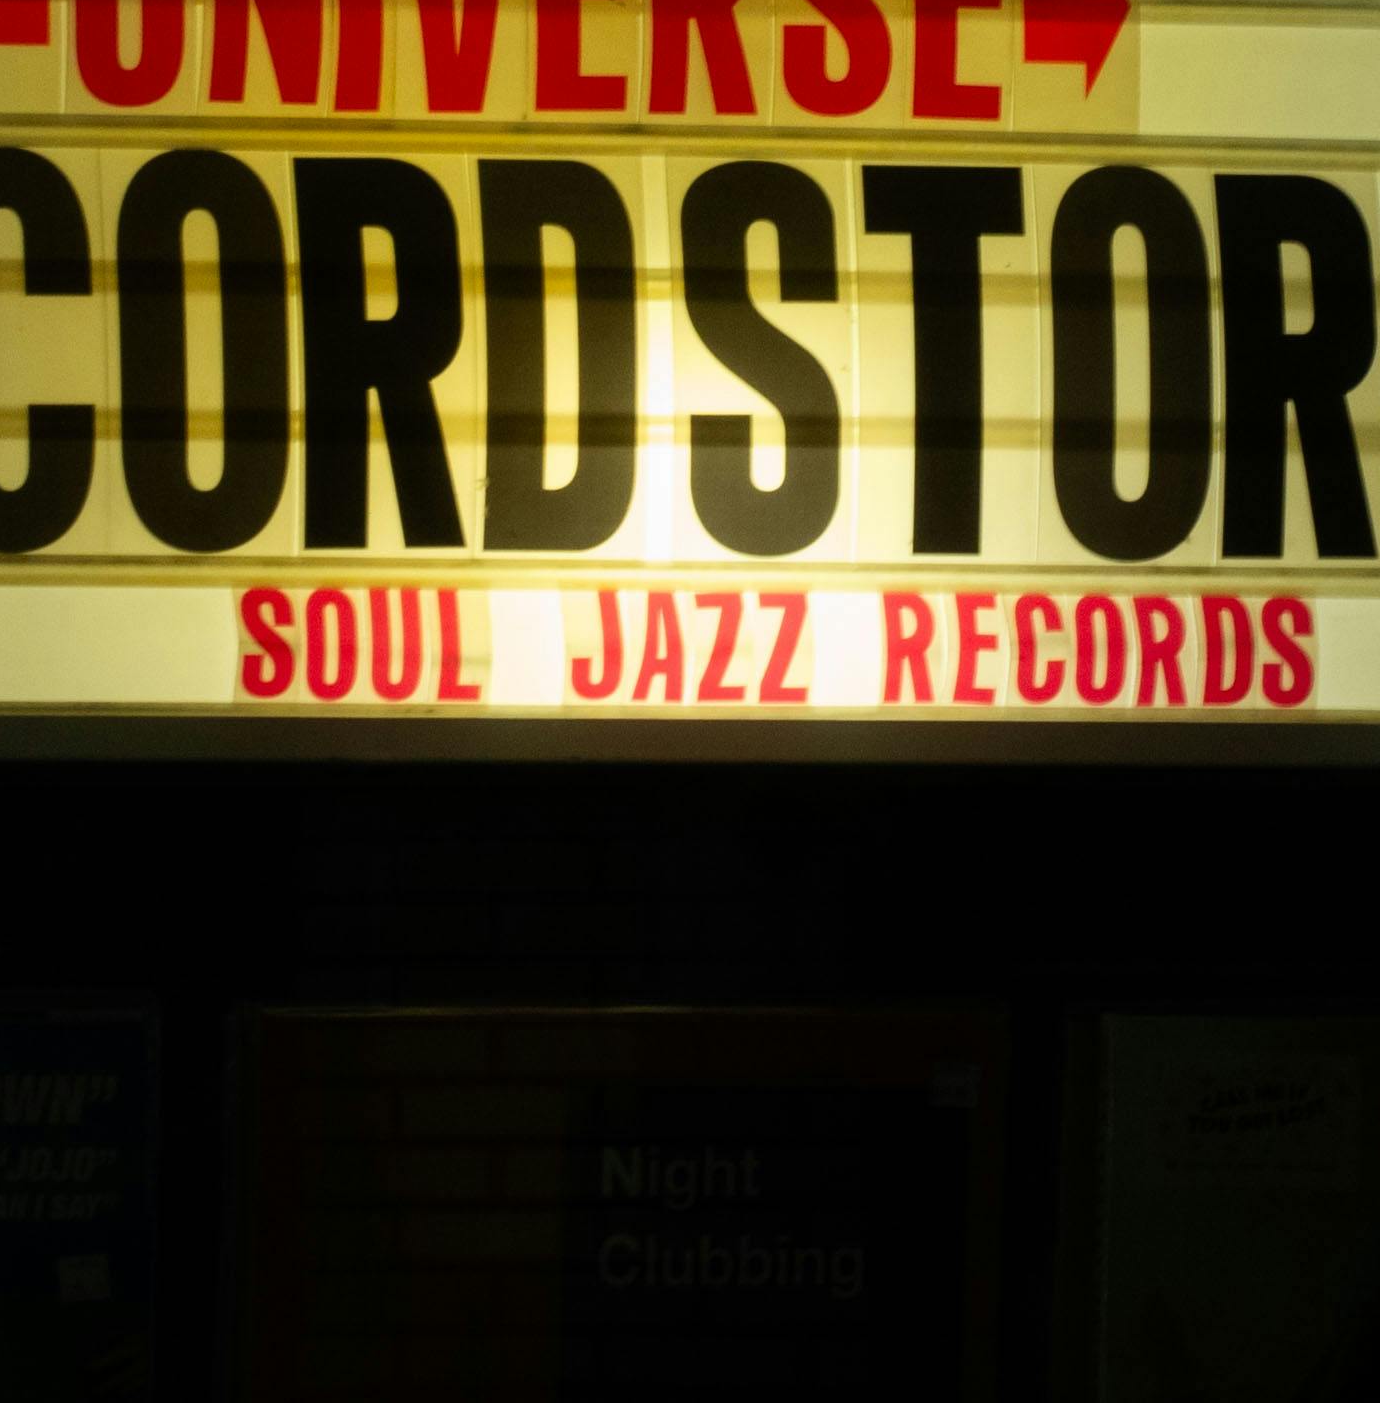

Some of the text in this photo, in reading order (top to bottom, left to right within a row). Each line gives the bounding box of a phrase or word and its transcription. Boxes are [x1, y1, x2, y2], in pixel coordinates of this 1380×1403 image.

[237, 582, 1315, 711] SOUL JAZZ RECORDS
[598, 1145, 764, 1210] Night
[596, 1233, 867, 1300] Clubbing
